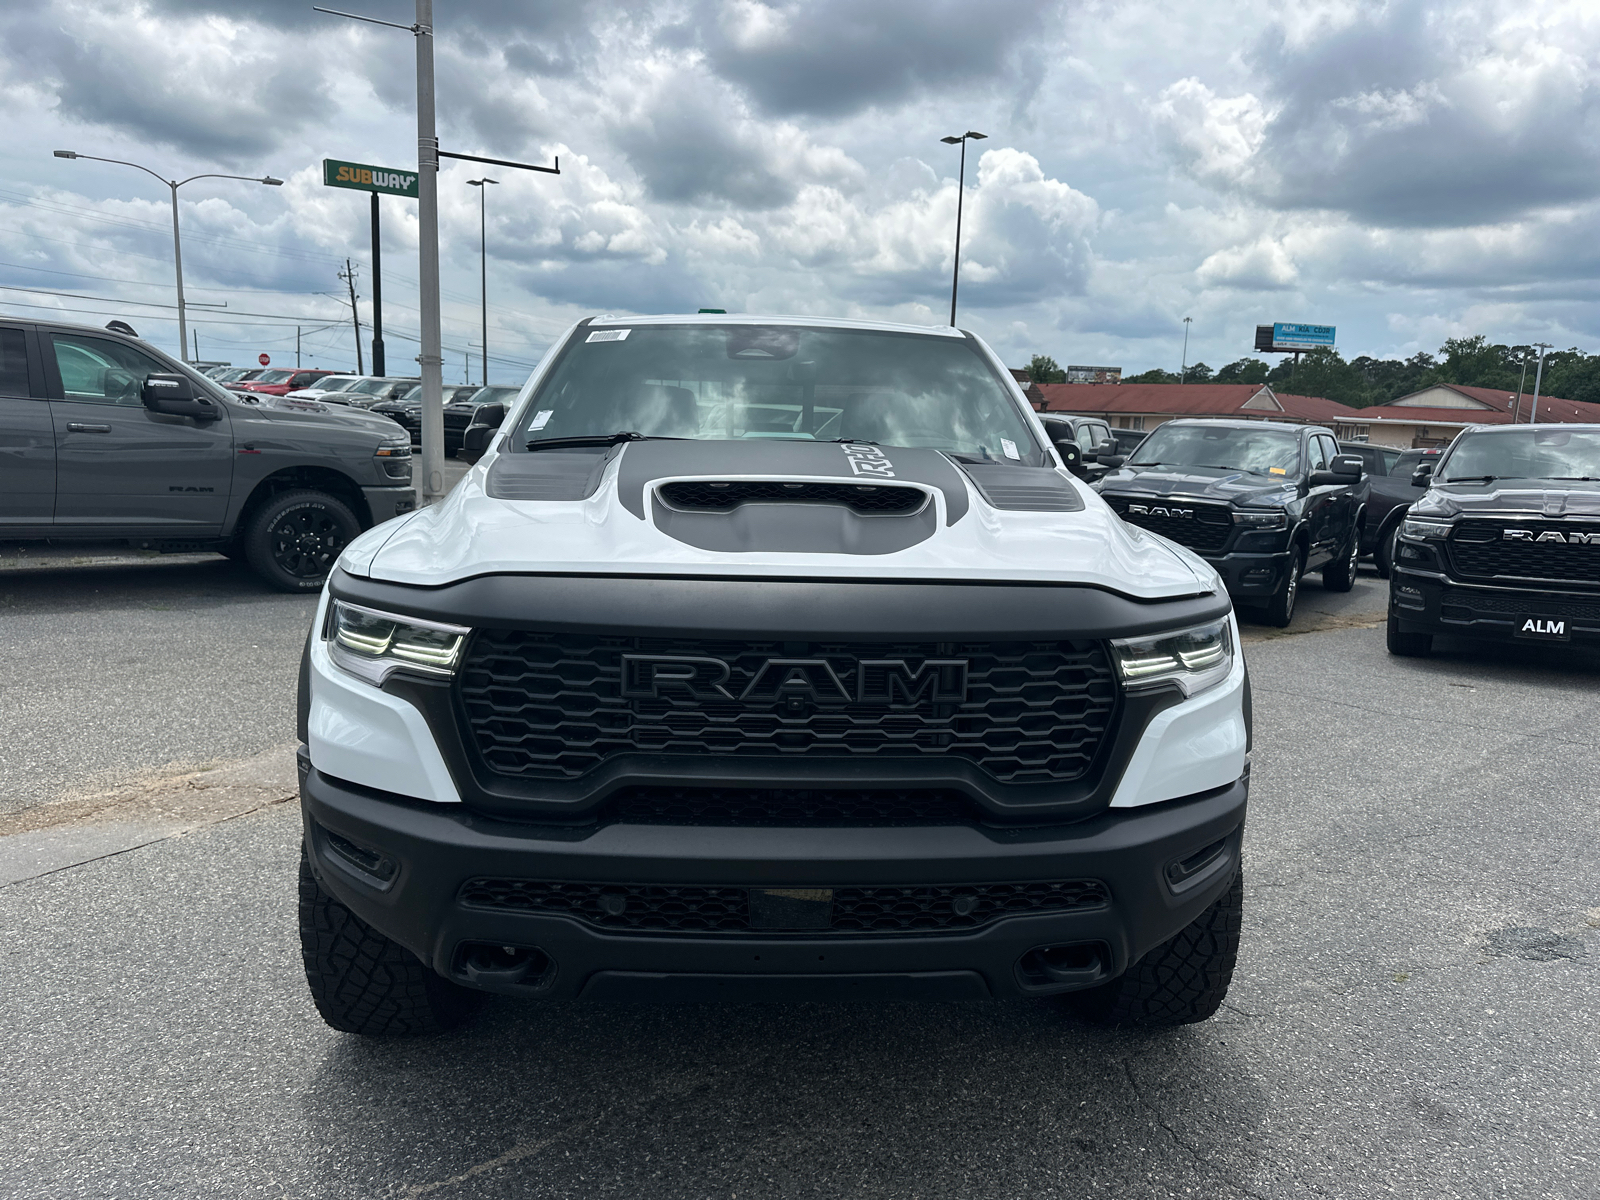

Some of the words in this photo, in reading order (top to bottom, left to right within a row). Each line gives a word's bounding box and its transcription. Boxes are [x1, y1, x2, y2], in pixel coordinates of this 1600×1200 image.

[336, 166, 416, 190] SUBWAY
[1281, 325, 1296, 333] ALM
[1298, 326, 1310, 334] KIA
[841, 444, 896, 477] RHO
[169, 485, 214, 493] RAM
[1128, 504, 1194, 519] RAM
[1502, 528, 1600, 545] RAM
[1521, 618, 1566, 635] ALM
[620, 653, 969, 703] RAM
